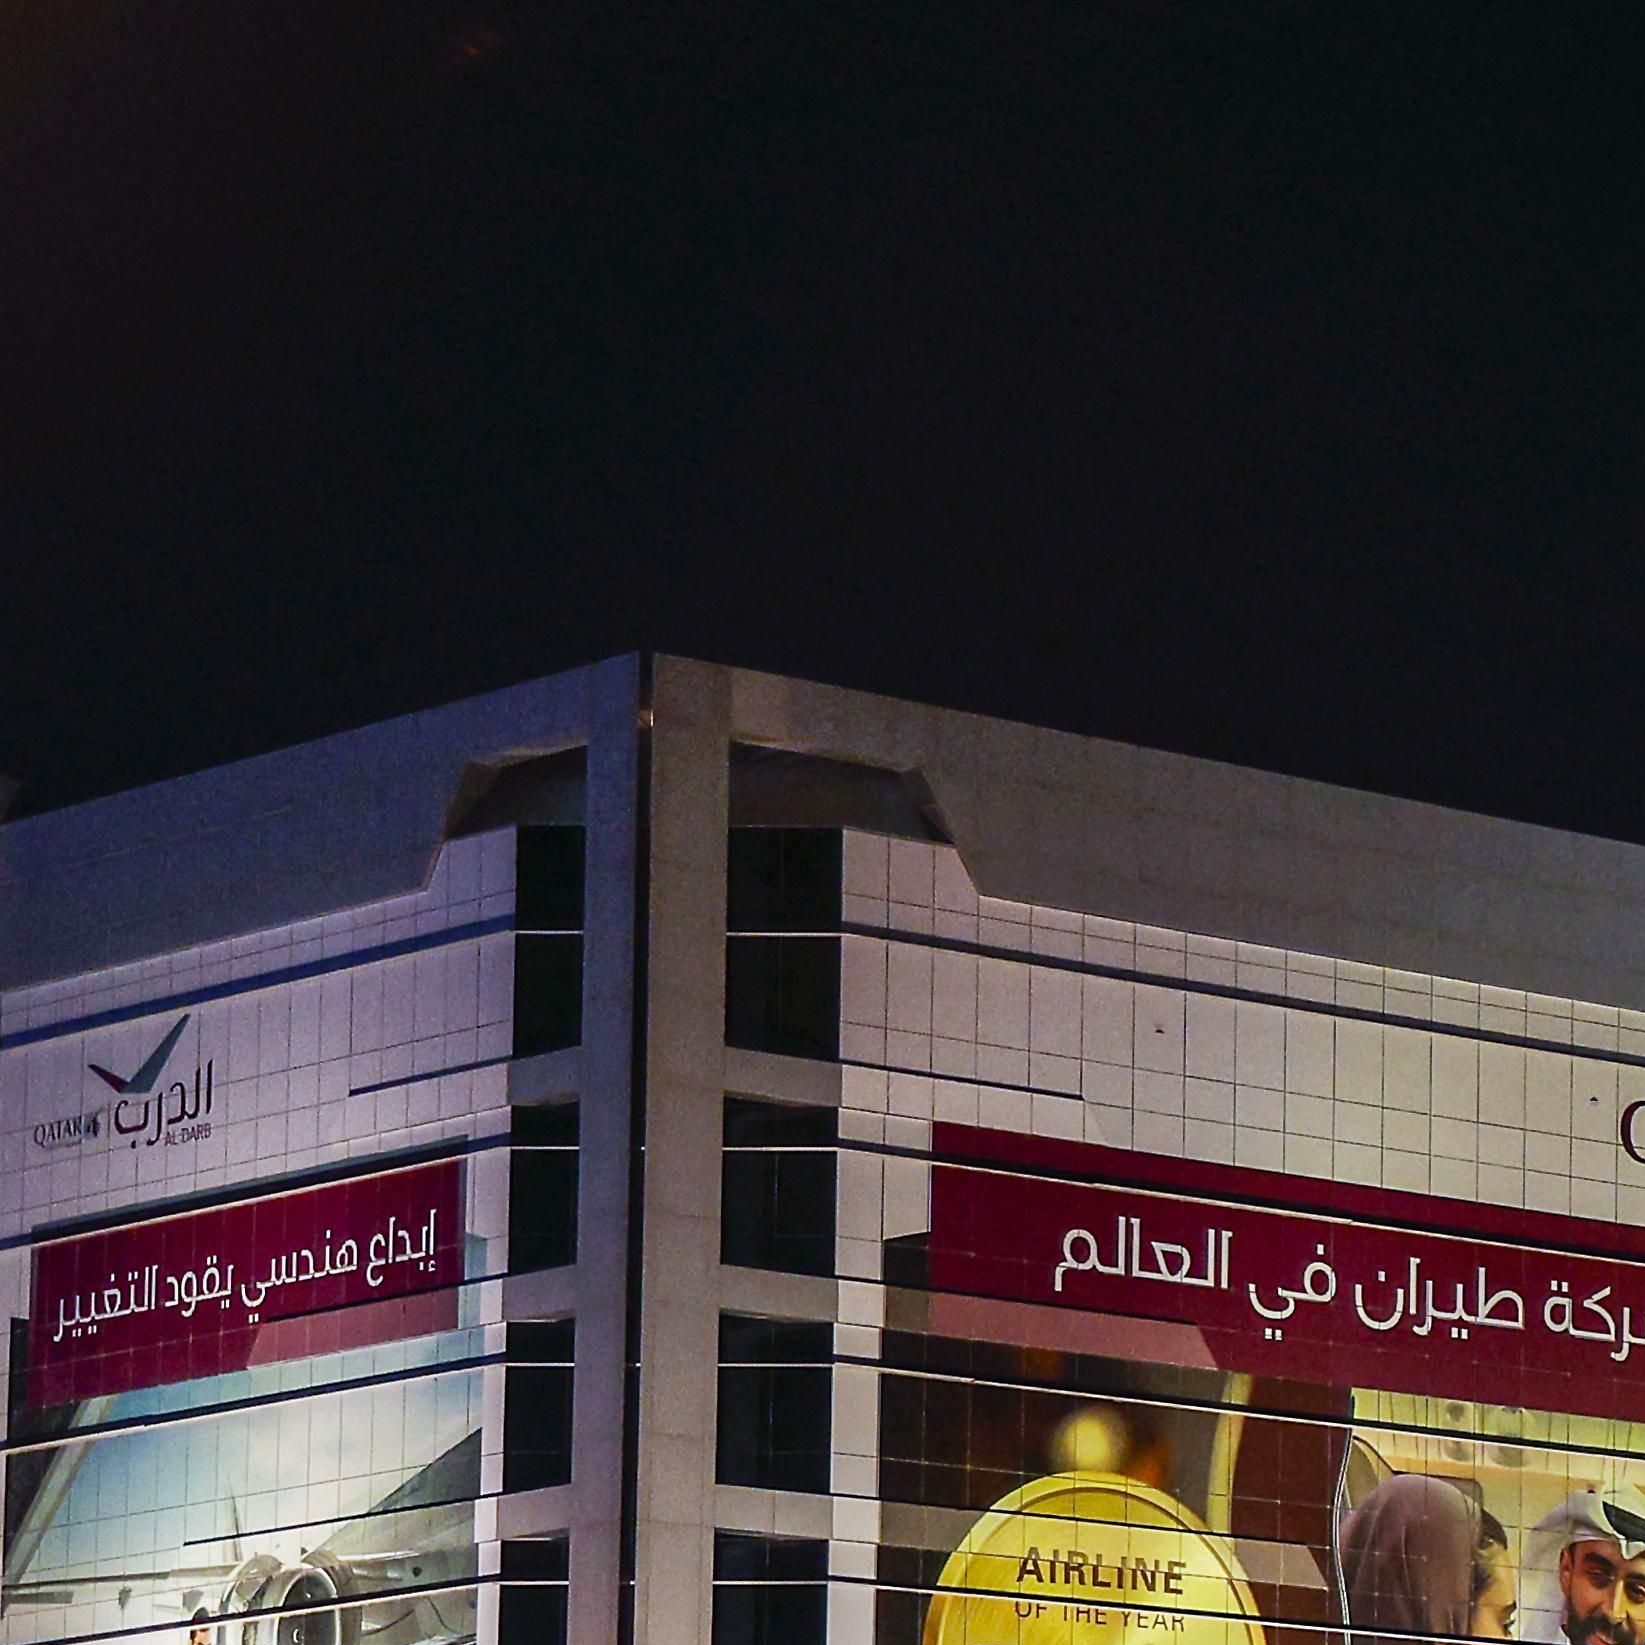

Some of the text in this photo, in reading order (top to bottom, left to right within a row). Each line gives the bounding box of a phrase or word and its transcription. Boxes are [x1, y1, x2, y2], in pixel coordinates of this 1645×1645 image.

[114, 1058, 214, 1149] الدرب
[52, 1208, 438, 1343] إبداع هندسي يقود التغيير
[1054, 1215, 1234, 1292] العالم
[1248, 1243, 1337, 1340] في
[1355, 1256, 1525, 1340] طيران
[1016, 1546, 1188, 1596] AIRLINE
[1014, 1600, 1186, 1633] OF THE YEAR
